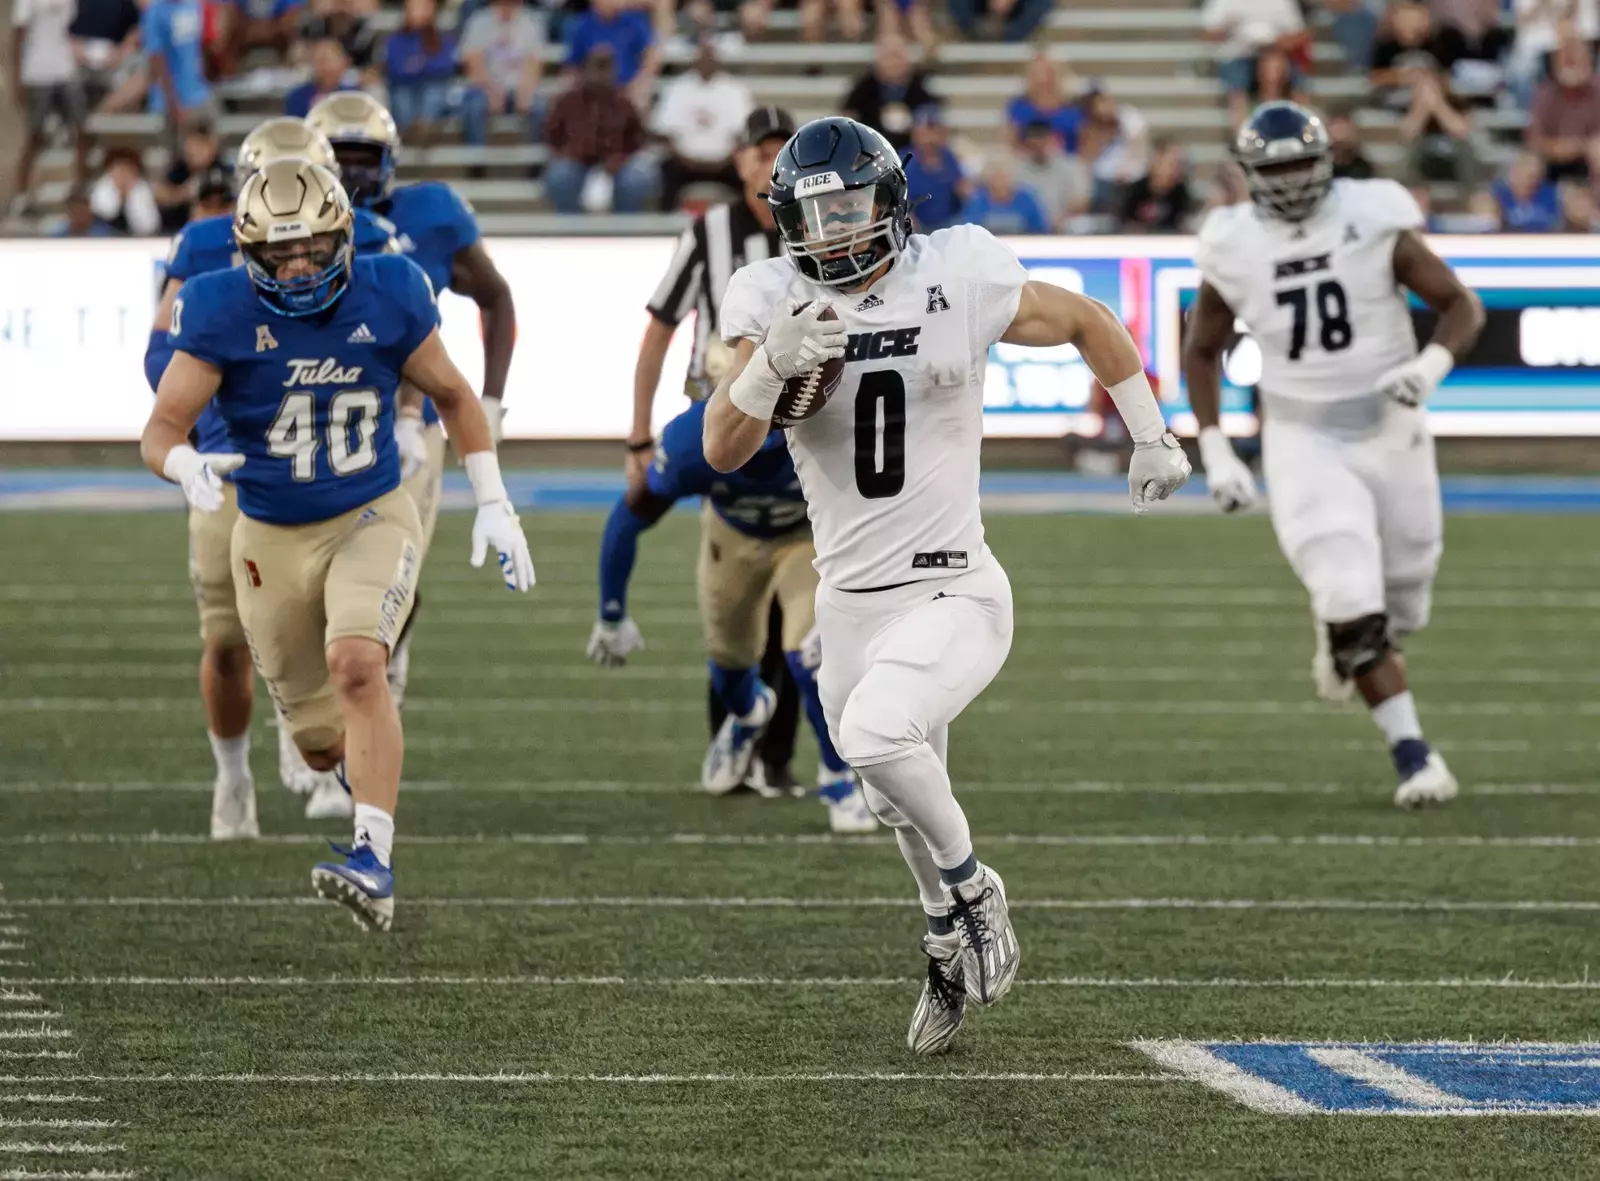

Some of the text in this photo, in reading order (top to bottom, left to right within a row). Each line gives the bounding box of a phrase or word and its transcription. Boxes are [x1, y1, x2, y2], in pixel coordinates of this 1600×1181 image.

[803, 173, 832, 189] RICE
[854, 299, 884, 312] adidas
[926, 284, 950, 314] A
[1275, 279, 1352, 361] 78
[256, 324, 279, 352] A
[283, 357, 362, 387] Tulsa
[265, 388, 380, 482] 40
[855, 369, 906, 499] 0
